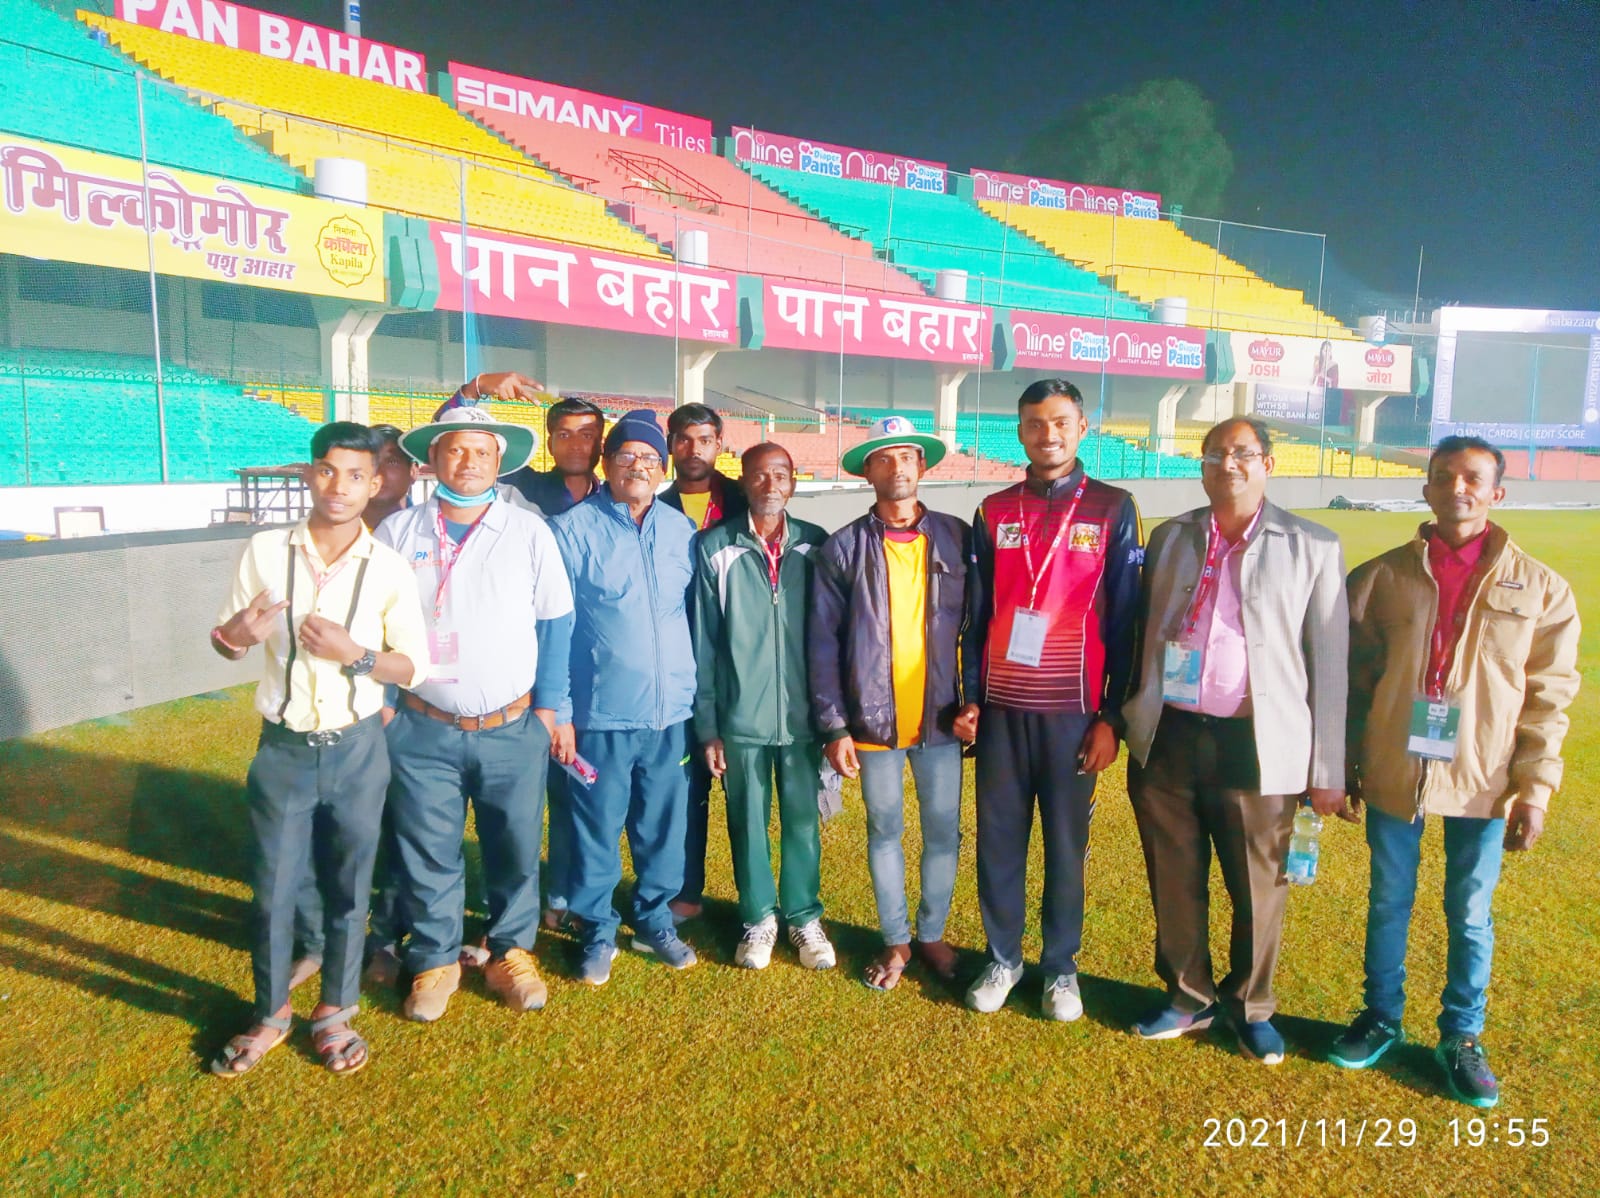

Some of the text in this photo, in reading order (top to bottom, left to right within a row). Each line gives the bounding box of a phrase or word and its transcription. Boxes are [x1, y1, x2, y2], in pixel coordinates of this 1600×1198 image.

[122, 0, 423, 92] PAN BAHAR
[457, 77, 706, 154] SOMANY Tiles
[801, 155, 841, 176] Pants
[907, 173, 943, 192] Pants
[1030, 190, 1065, 208] Pants
[207, 252, 296, 280] पशु आहार
[330, 253, 363, 269] Kapila
[440, 231, 730, 328] पान बहार
[770, 285, 987, 353] पान बहार
[1072, 341, 1109, 360] Pants
[1168, 349, 1201, 367] Pants
[1251, 346, 1282, 357] MAYUR
[1248, 364, 1280, 377] JOSH
[1366, 368, 1392, 385] जोश
[1256, 401, 1276, 410] WITH
[1256, 409, 1285, 418] DIGITAL
[1487, 428, 1519, 440] CARDS
[1524, 429, 1555, 440] CEDIT
[1557, 430, 1586, 440] SCORE
